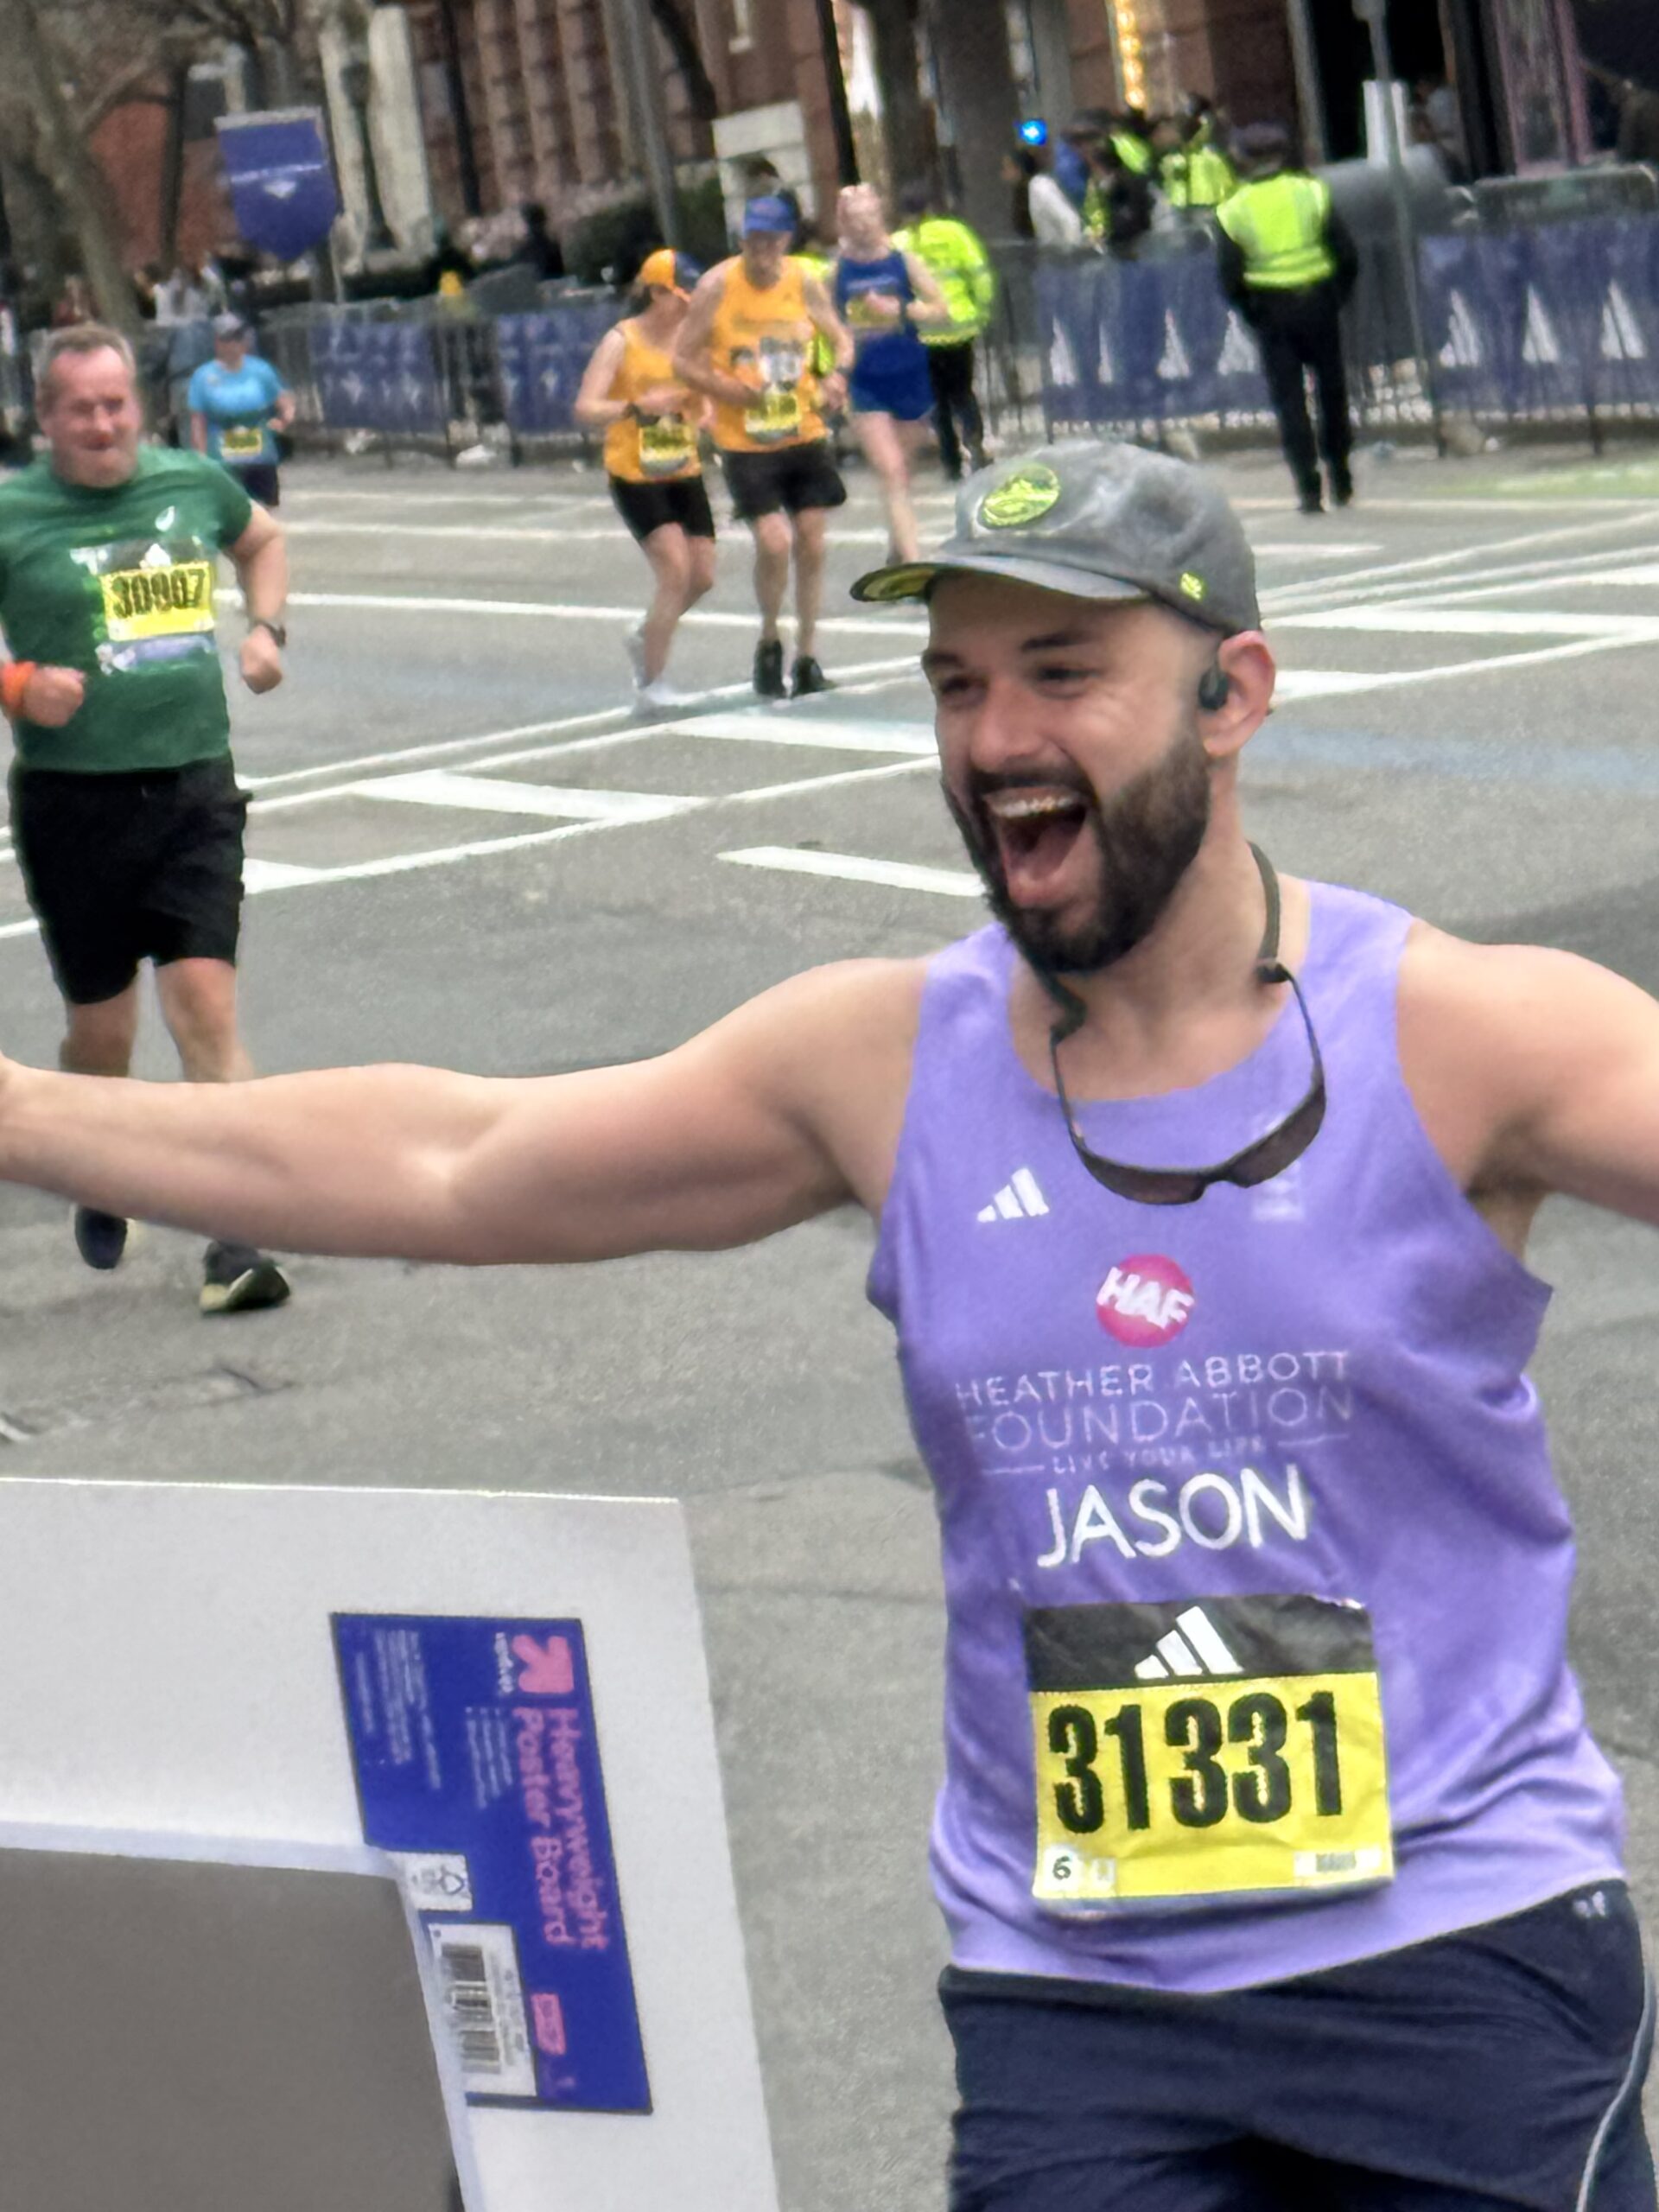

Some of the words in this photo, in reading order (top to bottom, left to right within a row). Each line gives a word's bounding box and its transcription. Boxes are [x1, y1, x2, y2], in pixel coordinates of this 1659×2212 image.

[1096, 1267, 1194, 1330] HAF
[955, 1363, 1154, 1409] HEATHER
[1173, 1351, 1350, 1388] ABBOTT
[964, 1385, 1353, 1452] FOUNDATION
[1037, 1465, 1307, 1567] JASON
[512, 1707, 551, 1829] Poster
[1047, 1690, 1343, 1834] 31331
[549, 1707, 608, 1950] Heavyweight
[1052, 1855, 1071, 1881] 6
[531, 1836, 576, 1945] Board
